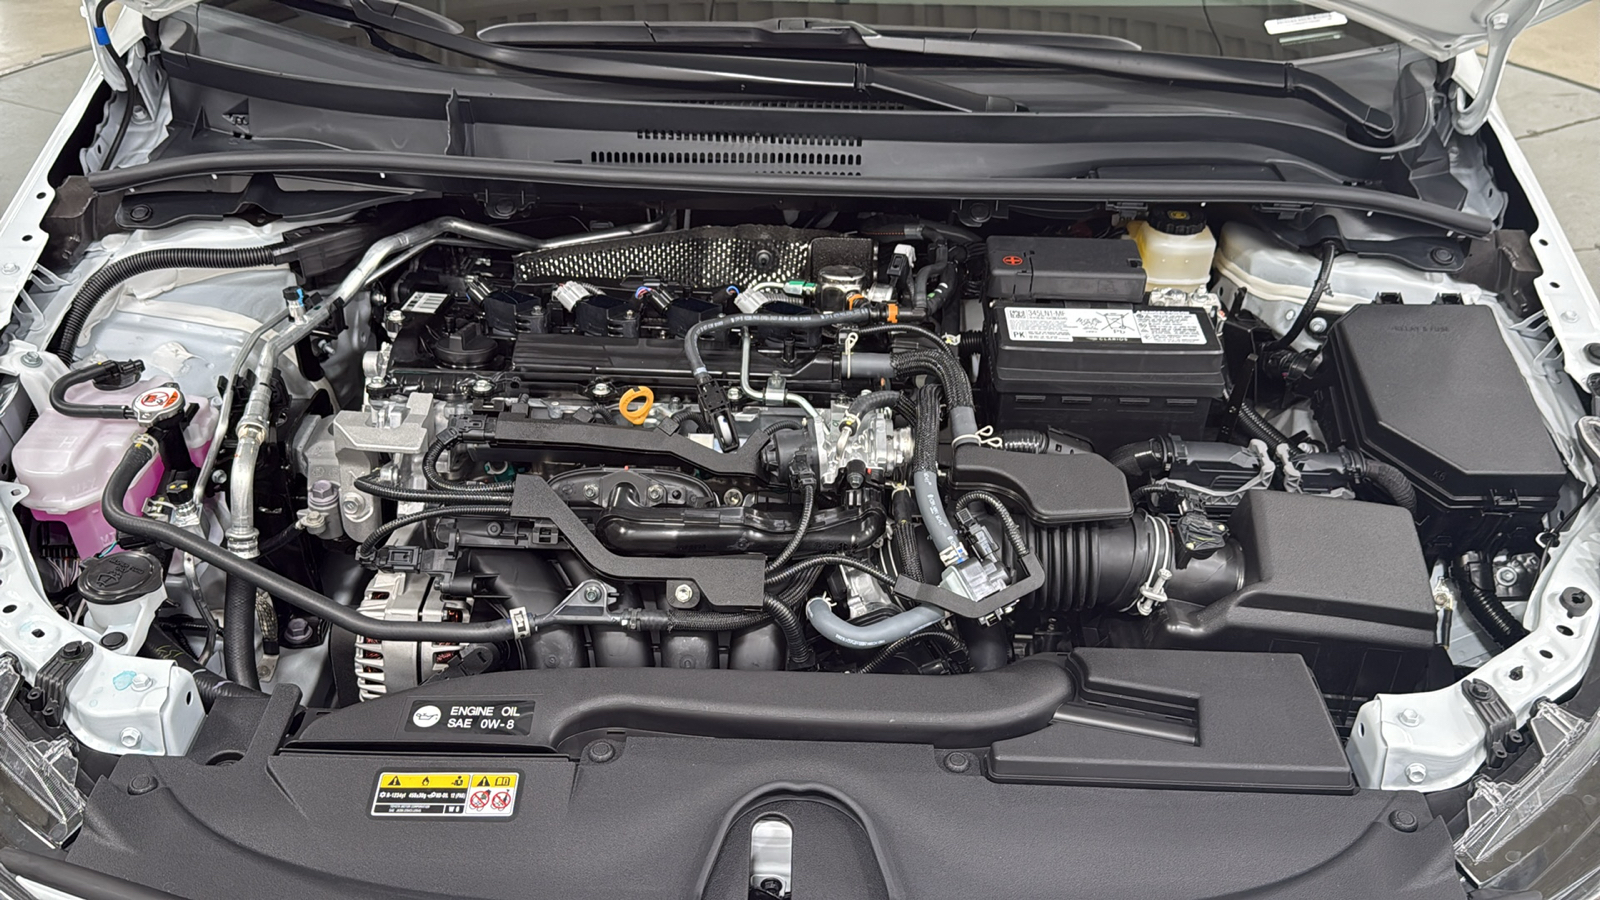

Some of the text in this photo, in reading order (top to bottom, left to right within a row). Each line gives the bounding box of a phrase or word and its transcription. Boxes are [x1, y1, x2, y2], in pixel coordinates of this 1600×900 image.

[450, 706, 520, 716] ENGINE OIL
[447, 718, 473, 728] SAE
